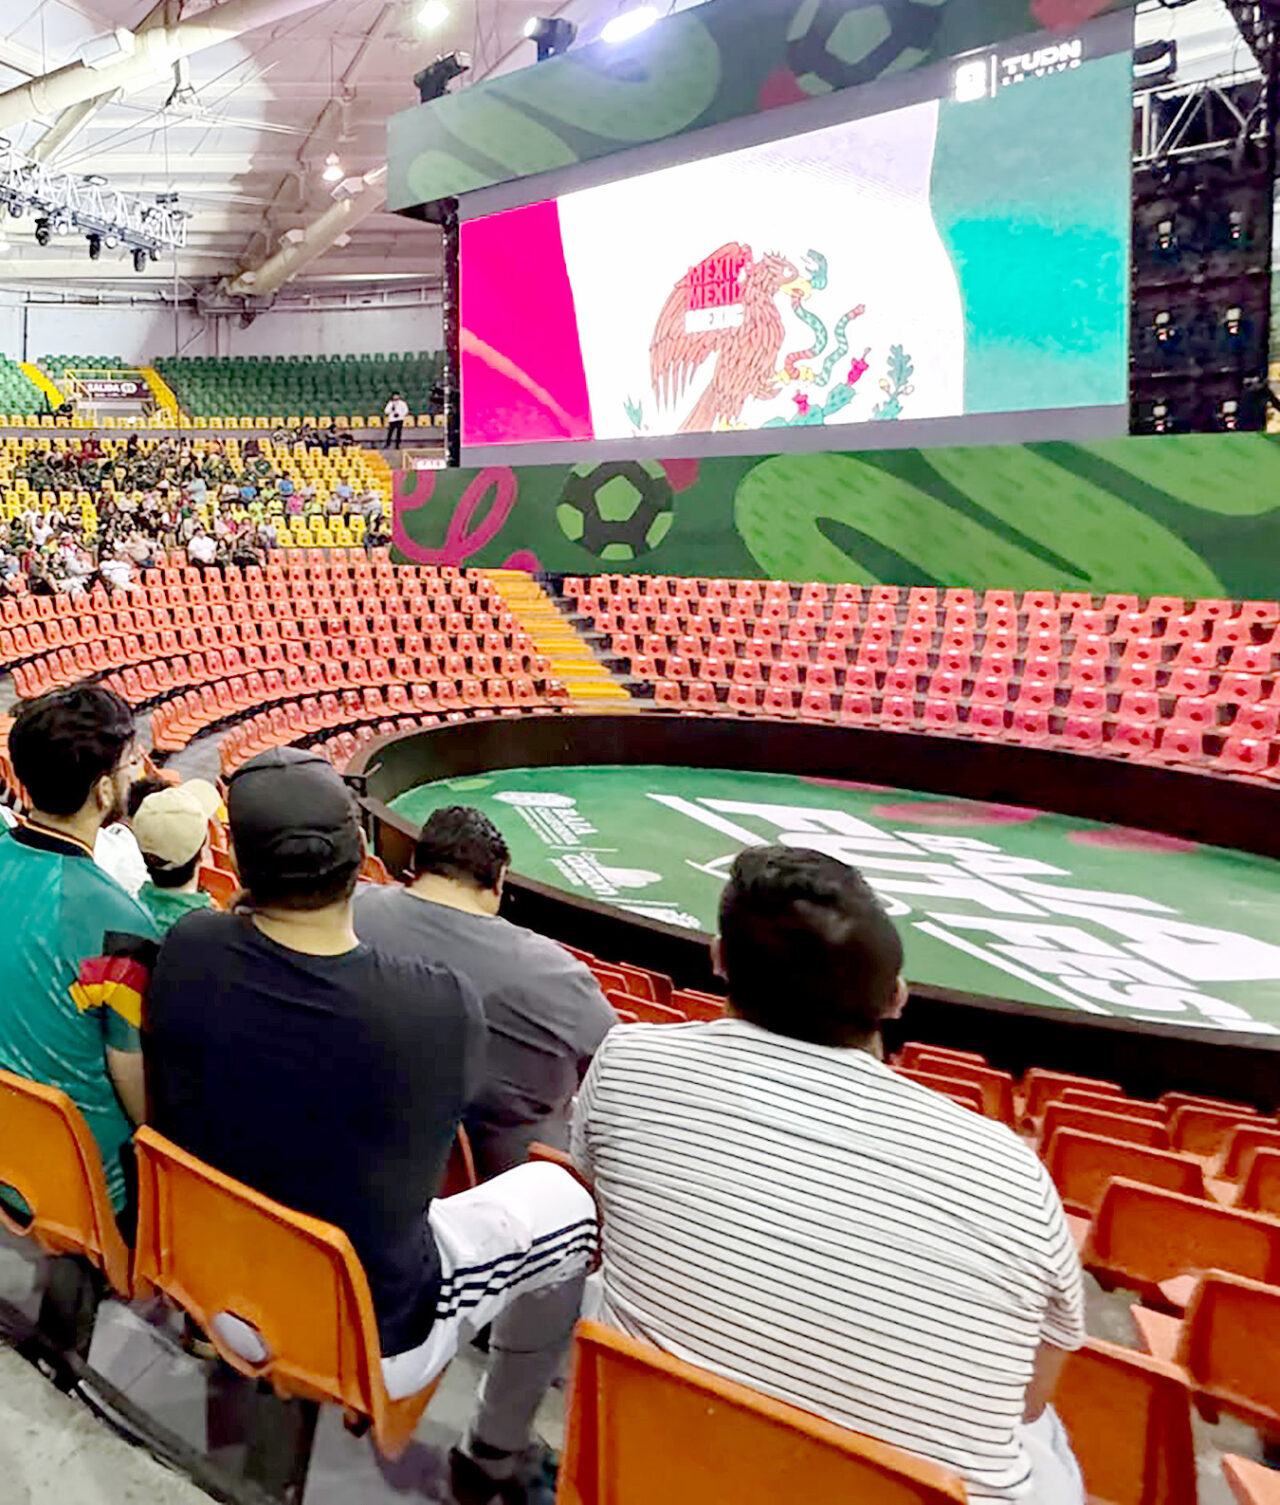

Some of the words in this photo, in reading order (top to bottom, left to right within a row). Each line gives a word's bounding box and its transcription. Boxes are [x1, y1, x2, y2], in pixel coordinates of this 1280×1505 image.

[1002, 39, 1082, 75] TUDN
[1035, 59, 1082, 77] VIVO
[87, 383, 120, 393] SALIDA
